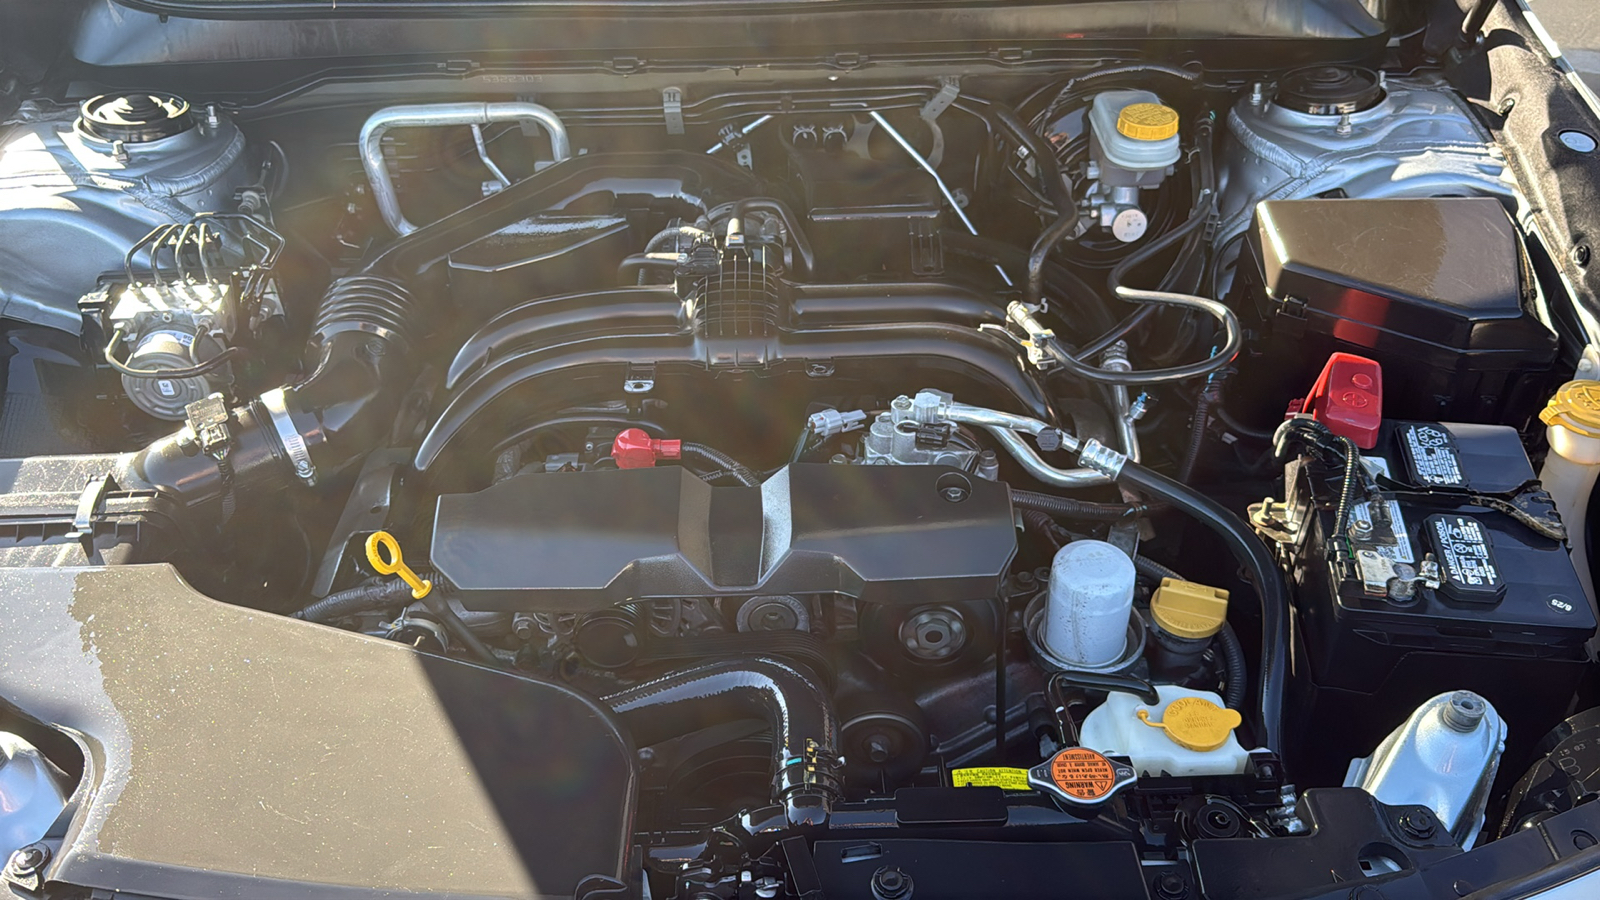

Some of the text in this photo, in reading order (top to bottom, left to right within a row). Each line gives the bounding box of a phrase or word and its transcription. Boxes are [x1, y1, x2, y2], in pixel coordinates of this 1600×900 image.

[1435, 521, 1449, 545] POISON
[1444, 550, 1459, 575] DANGER
[1064, 781, 1095, 789] WARNING
